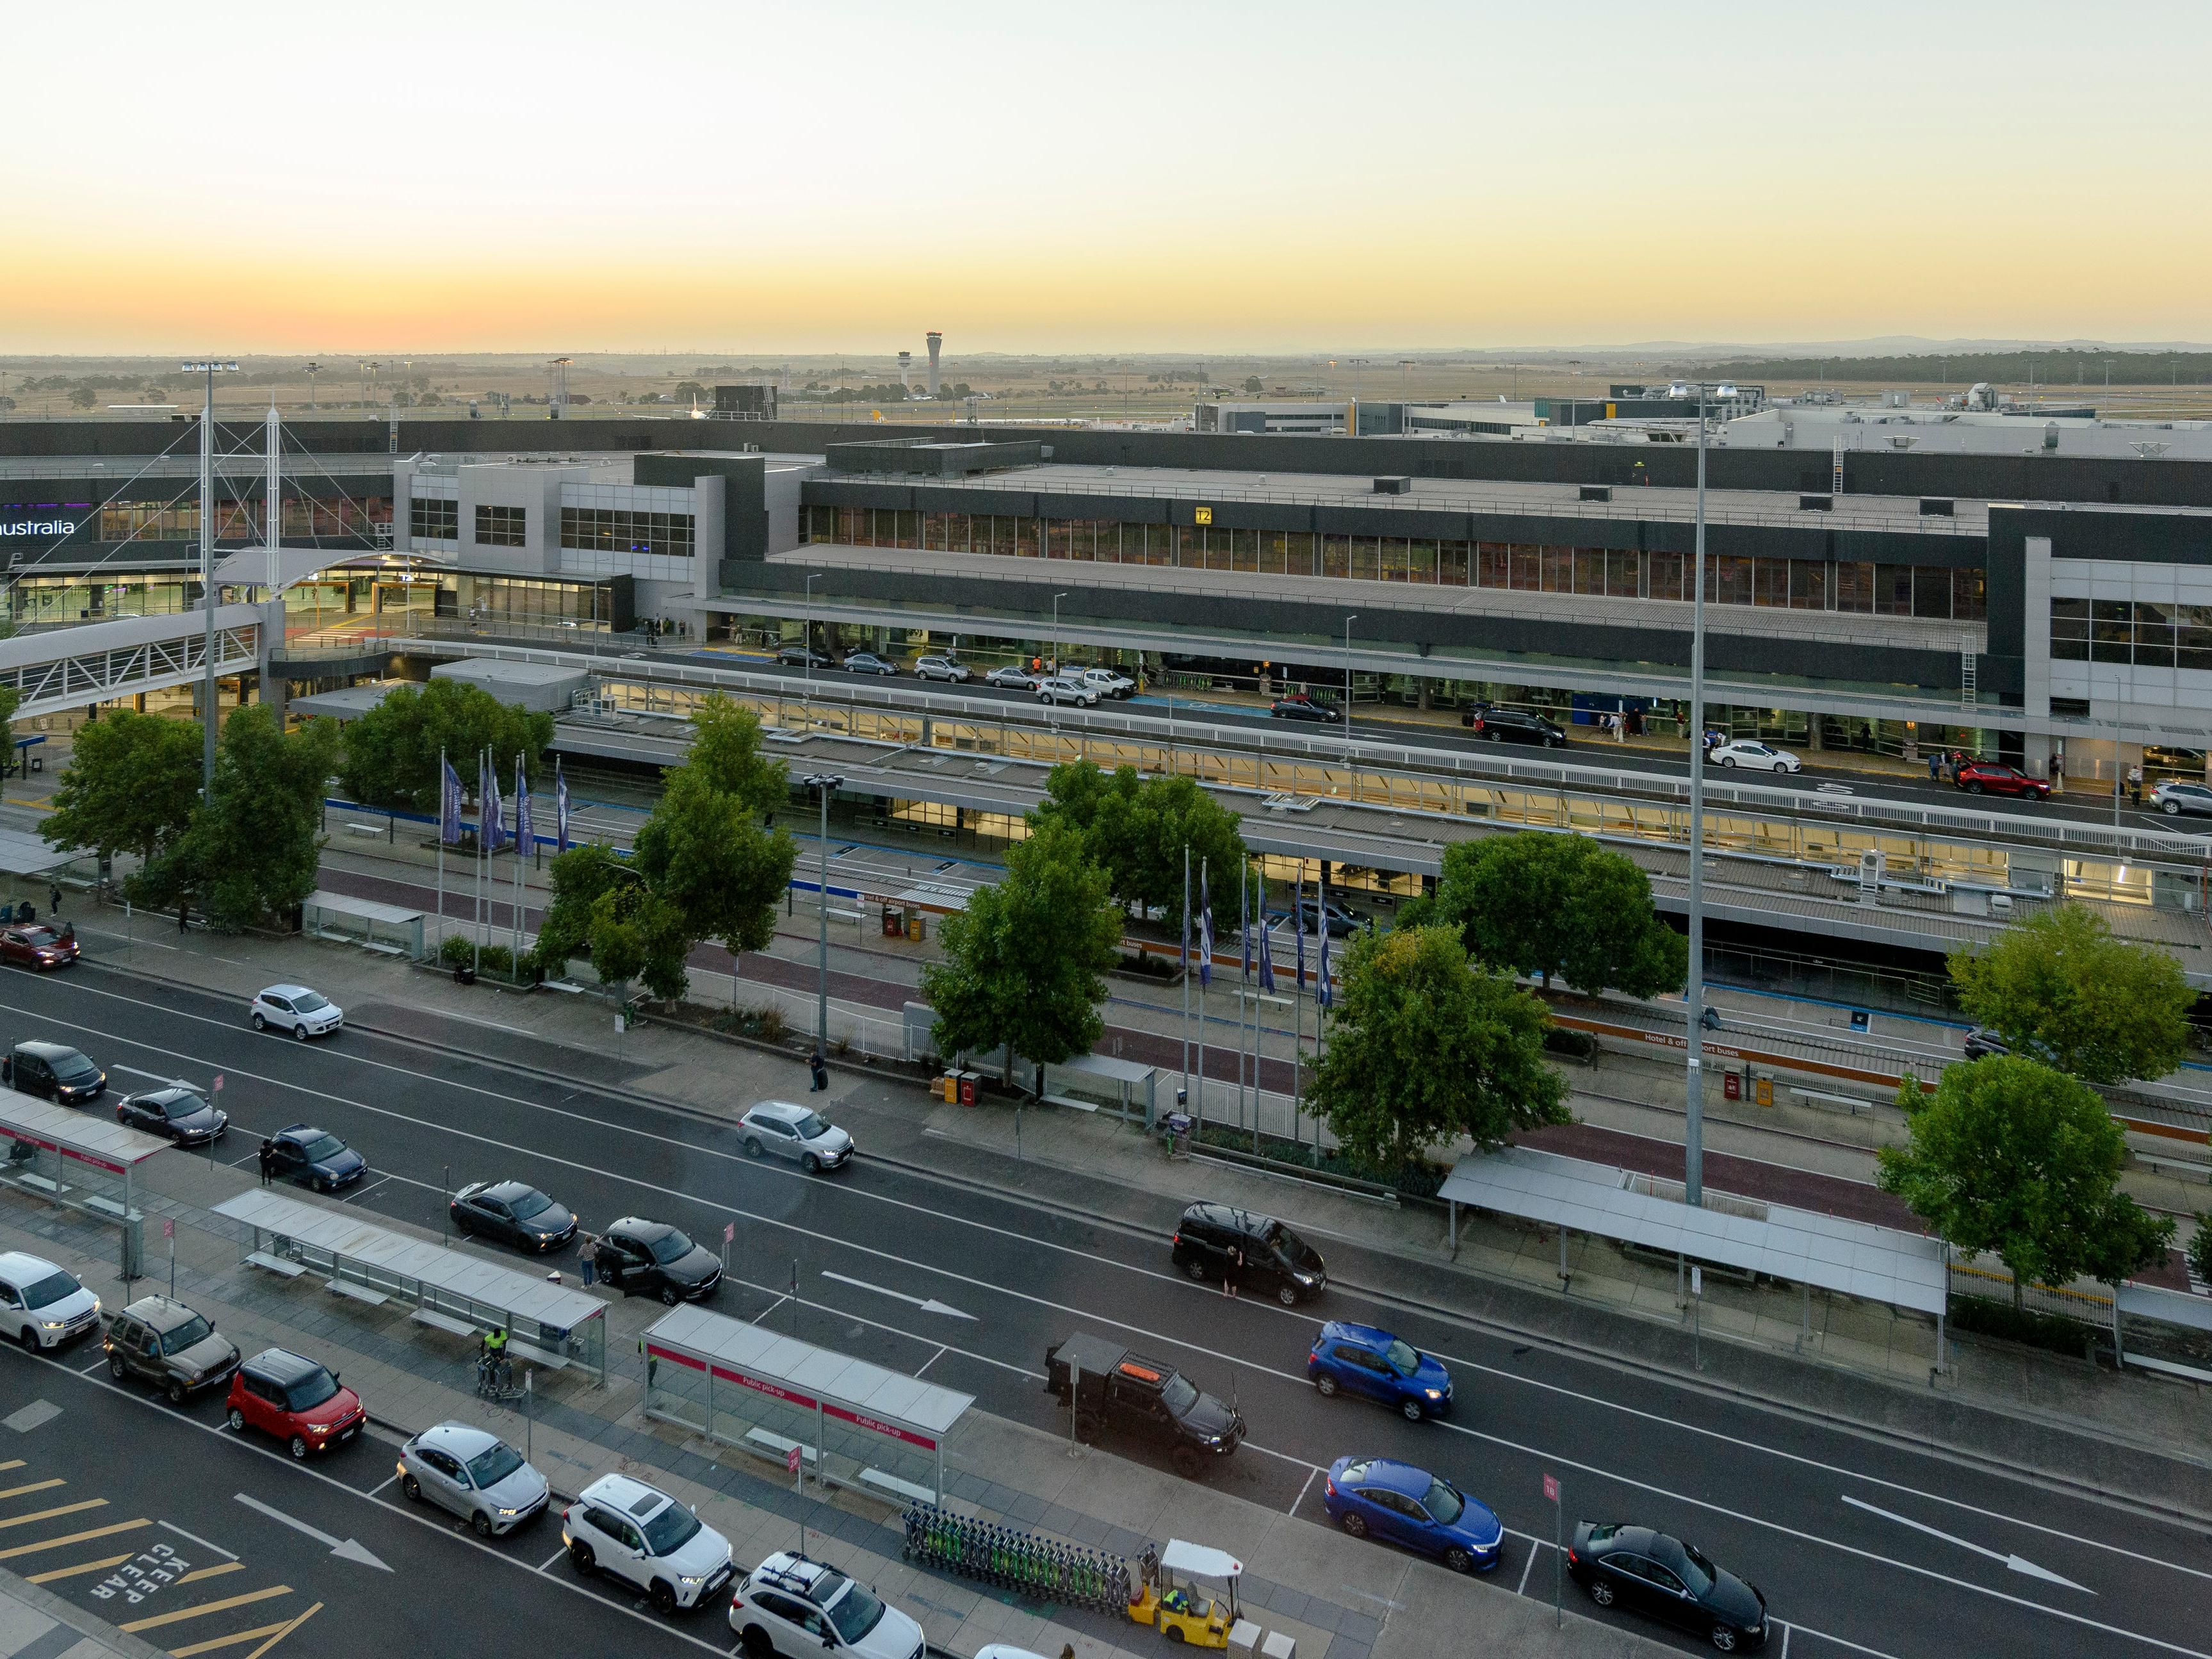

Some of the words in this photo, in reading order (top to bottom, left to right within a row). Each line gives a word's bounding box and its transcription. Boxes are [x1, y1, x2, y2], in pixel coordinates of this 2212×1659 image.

[1197, 511, 1210, 520] T2
[0, 520, 75, 535] ustralia
[1816, 783, 1855, 795] 40
[906, 901, 920, 909] buses
[1126, 939, 1143, 948] buses
[1645, 1033, 1666, 1043] Hotel
[1667, 1037, 1674, 1045] &
[1717, 1046, 1739, 1057] buses
[743, 1377, 761, 1389] Public
[762, 1384, 785, 1397] pick-up
[856, 1415, 876, 1428] Public
[877, 1423, 901, 1437] pick-up
[90, 1543, 175, 1599] CLEAR
[125, 1557, 191, 1603] KEEP
